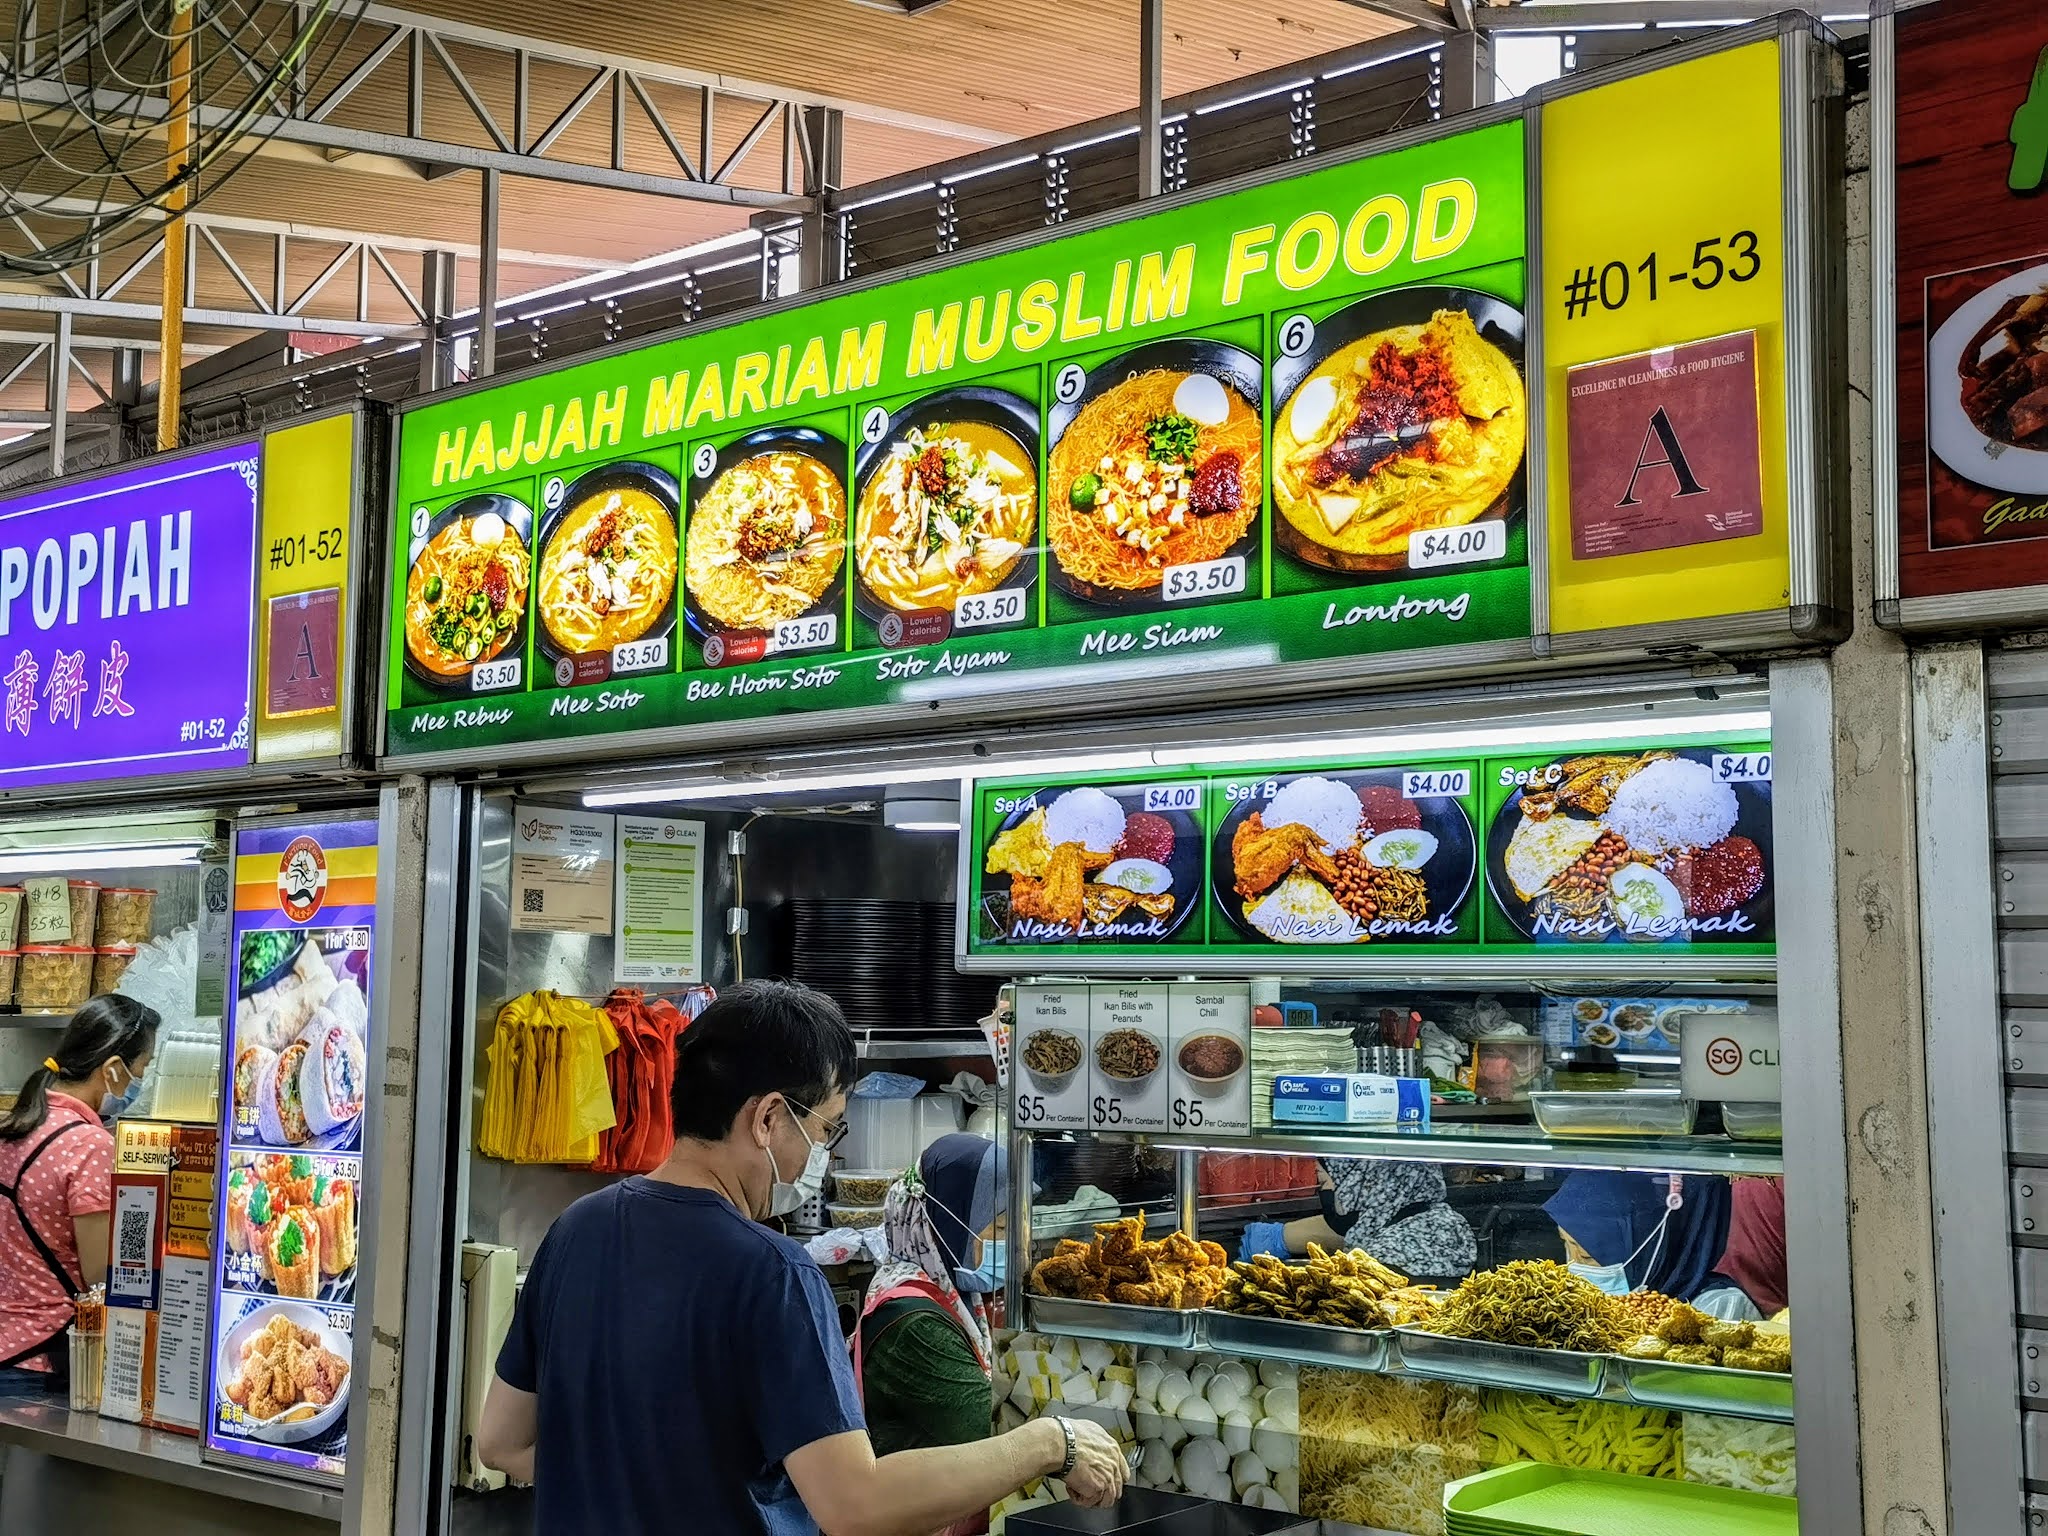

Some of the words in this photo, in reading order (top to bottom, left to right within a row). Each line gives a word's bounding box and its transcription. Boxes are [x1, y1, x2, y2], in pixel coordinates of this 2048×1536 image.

[1564, 230, 1761, 320] #01-53
[431, 385, 626, 487] HAJJAH
[643, 320, 887, 437] MARIAM
[907, 243, 1195, 378] MUSLIM
[1222, 177, 1477, 306] FOOD
[1285, 321, 1304, 350] 6
[1060, 370, 1080, 397] 5
[1572, 379, 1618, 398] EXCELLENCE
[1618, 376, 1627, 387] IN
[1627, 366, 1678, 386] CLEANLINESS
[1679, 365, 1686, 375] &
[1687, 361, 1709, 373] FOOD
[1710, 351, 1746, 368] HYGIENE
[865, 411, 883, 438] 4
[698, 449, 714, 474] 3
[1613, 404, 1710, 508] A
[548, 482, 561, 505] 2
[415, 513, 425, 533] 1
[1983, 496, 2048, 534] Gad
[270, 527, 342, 570] #01-52
[1421, 530, 1487, 560] $4.00
[0, 509, 192, 636] POPIAH
[1169, 564, 1237, 597] $3.50
[909, 617, 930, 627] Lower
[932, 615, 942, 624] in
[959, 596, 1019, 625] $3.50
[1323, 593, 1470, 630] Lontong
[730, 636, 748, 646] Lower
[750, 635, 758, 643] in
[779, 621, 830, 648] $3.50
[909, 624, 942, 637] calories
[1081, 632, 1138, 656] Mee
[1142, 621, 1223, 649] Siam
[287, 621, 321, 682] A
[617, 644, 662, 668] $3.50
[730, 645, 758, 655] calories
[476, 664, 516, 688] $3.50
[578, 666, 604, 677] calories
[579, 660, 596, 669] Lower
[876, 656, 928, 681] Soto
[933, 648, 1011, 678] Ayam
[687, 680, 725, 702] Bee
[729, 673, 787, 697] Hoon
[790, 667, 841, 691] Soto
[550, 694, 594, 717] Mee
[598, 689, 645, 711] Soto
[180, 717, 225, 742] #01-52
[411, 714, 449, 734] Mee
[453, 707, 513, 729] Rebus
[1408, 772, 1464, 795] $4.00
[1500, 766, 1537, 786] Set
[1540, 764, 1562, 784] C
[1149, 788, 1195, 808] $4.00
[1225, 783, 1257, 801] Set
[1261, 781, 1278, 799] B
[994, 797, 1021, 813] Set
[1024, 796, 1038, 812] A
[538, 835, 557, 843] Agency
[676, 829, 697, 838] CLEAN
[31, 885, 61, 903] $18
[30, 915, 70, 931] 55粒
[1012, 920, 1073, 939] Nasi
[1077, 917, 1168, 938] Lemak
[1271, 914, 1343, 936] Nasi
[1348, 913, 1459, 937] Lemak
[1532, 913, 1617, 936] Nasi
[1625, 909, 1756, 938] Lemak
[330, 932, 344, 949] For
[345, 931, 367, 947] $1.80
[1043, 995, 1062, 1004] Fried
[1119, 990, 1138, 999] Fried
[1195, 996, 1225, 1005] Sambal
[1036, 1007, 1051, 1016] Ikan
[1052, 1007, 1067, 1016] Bilis
[1104, 1002, 1120, 1011] Ikan
[1121, 1002, 1137, 1011] Bilis
[1138, 1002, 1153, 1011] with
[1200, 1008, 1219, 1018] Chilli
[1112, 1014, 1143, 1024] Peanuts
[1711, 1048, 1738, 1065] SG
[1018, 1094, 1045, 1124] $5
[1046, 1114, 1057, 1122] Per
[1057, 1114, 1086, 1123] Container
[1093, 1096, 1122, 1126] $5
[1123, 1116, 1134, 1124] Per
[1135, 1117, 1164, 1126] Container
[1173, 1098, 1203, 1129] $5
[1204, 1119, 1216, 1127] Per
[1217, 1120, 1249, 1129] Container
[122, 1151, 170, 1166] SELF-SERVIC
[335, 1160, 357, 1178] $3.50
[328, 1313, 350, 1330] $2.50
